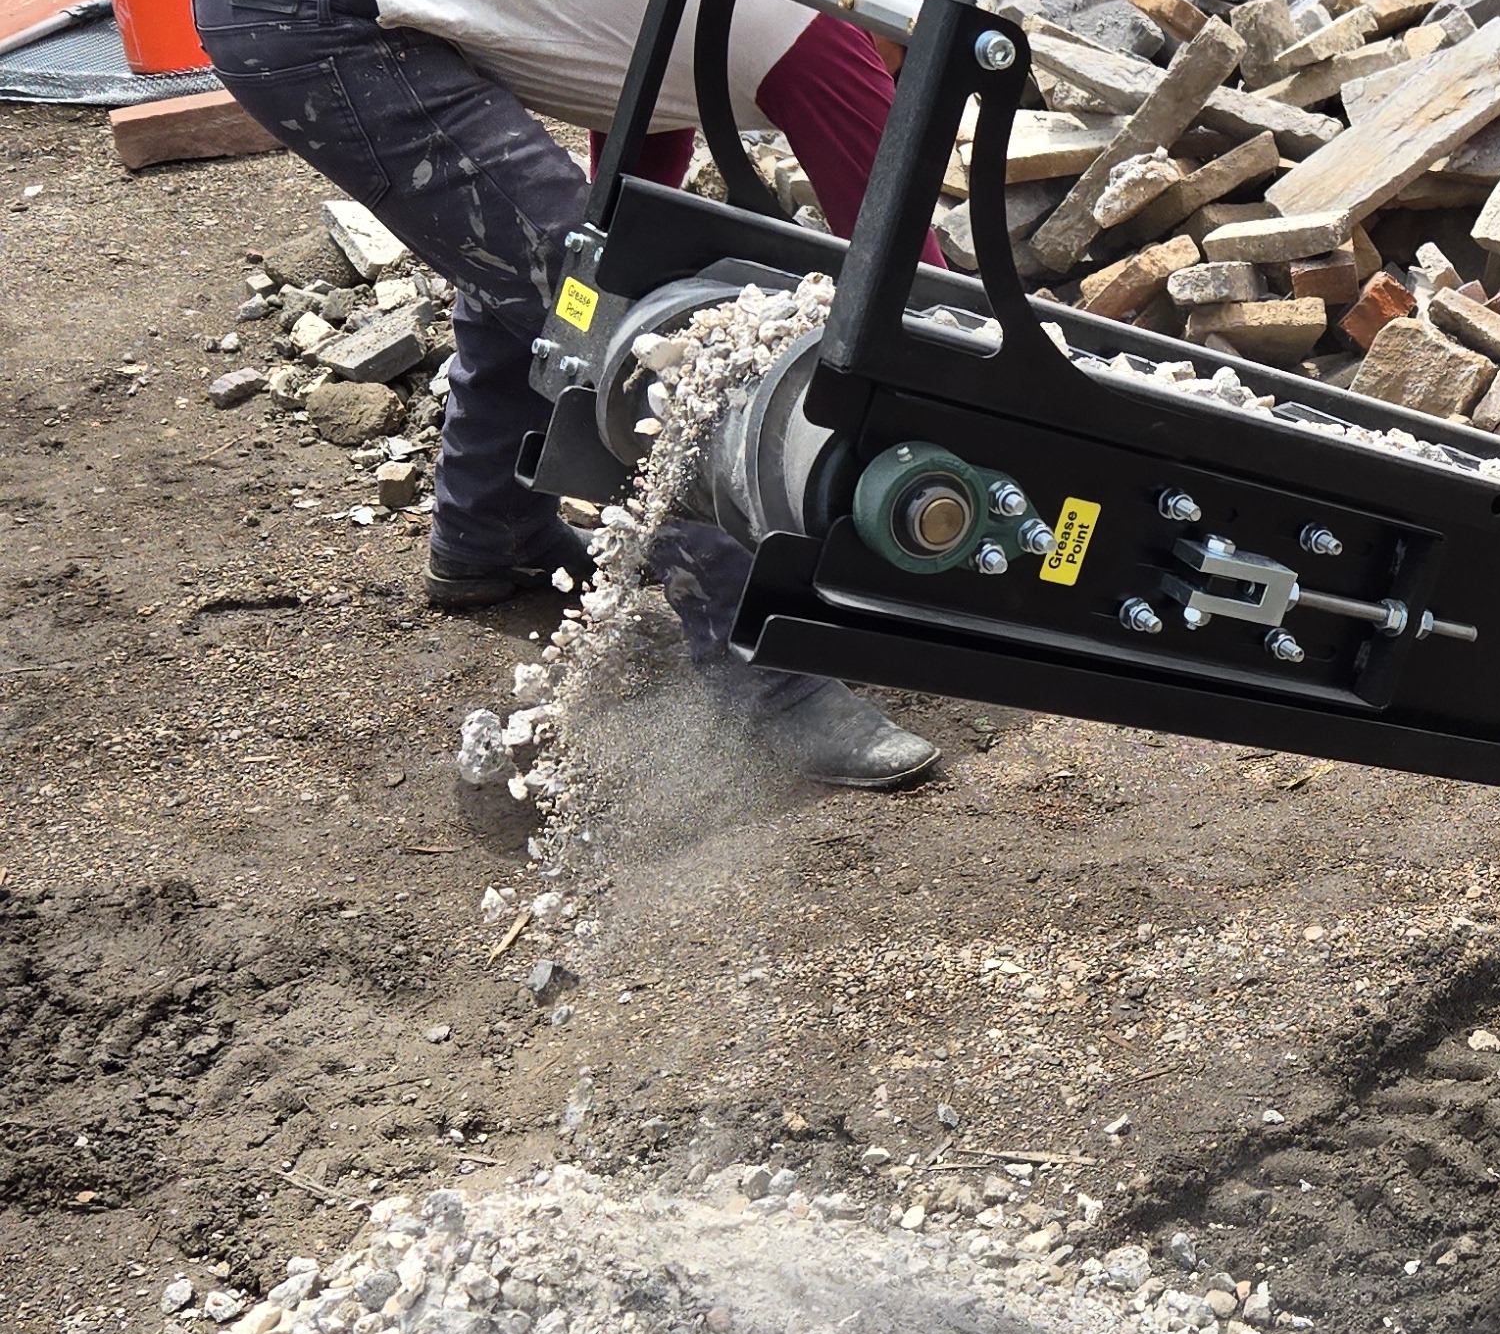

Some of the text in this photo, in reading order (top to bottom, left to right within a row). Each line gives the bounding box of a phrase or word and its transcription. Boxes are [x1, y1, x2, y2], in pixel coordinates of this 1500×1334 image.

[567, 284, 591, 308] Grease
[1048, 510, 1078, 570] Grease
[1065, 523, 1090, 565] Point
